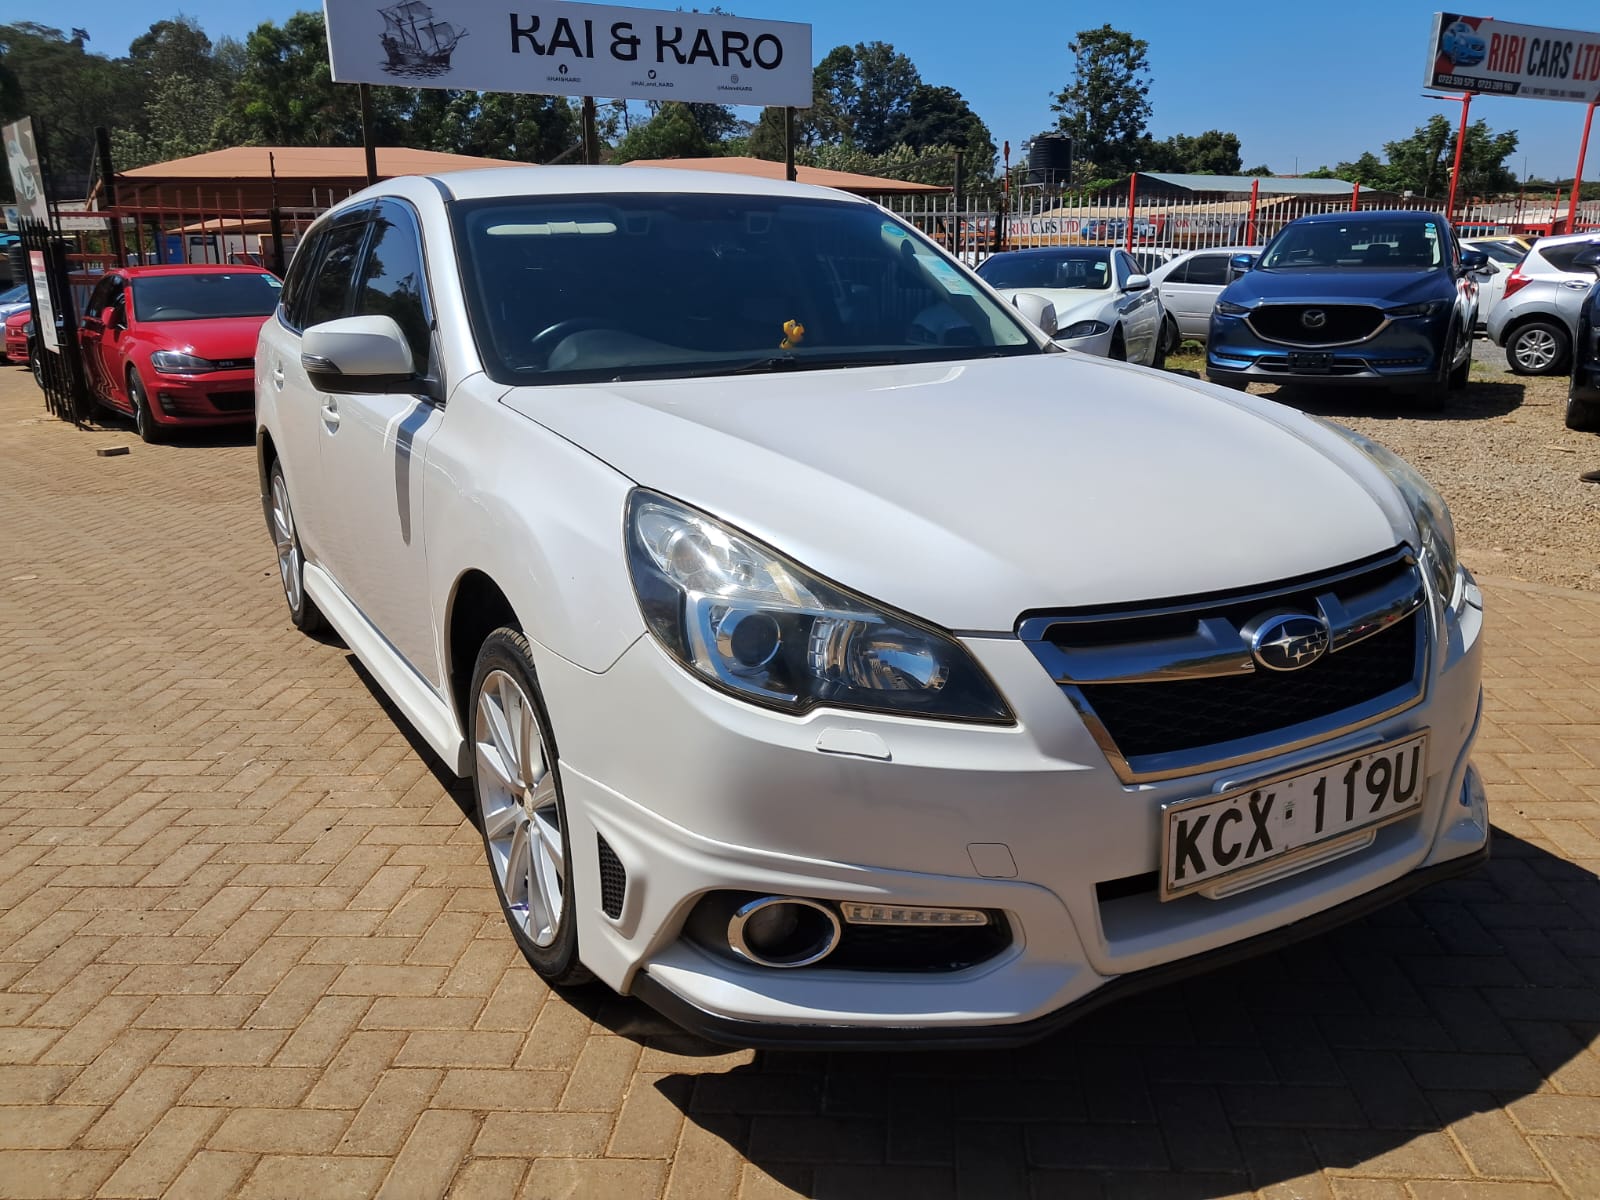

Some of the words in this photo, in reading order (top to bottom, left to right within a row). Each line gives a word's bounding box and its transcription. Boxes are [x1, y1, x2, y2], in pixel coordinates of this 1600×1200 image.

[510, 13, 594, 58] KAI
[610, 22, 640, 61] &
[655, 26, 783, 70] KARO
[1487, 33, 1525, 74] RIRI
[1527, 38, 1573, 79] CARS
[1031, 222, 1057, 234] CARS
[1060, 220, 1079, 233] LTD
[1175, 791, 1275, 880] KCX
[1313, 746, 1420, 834] 119U
